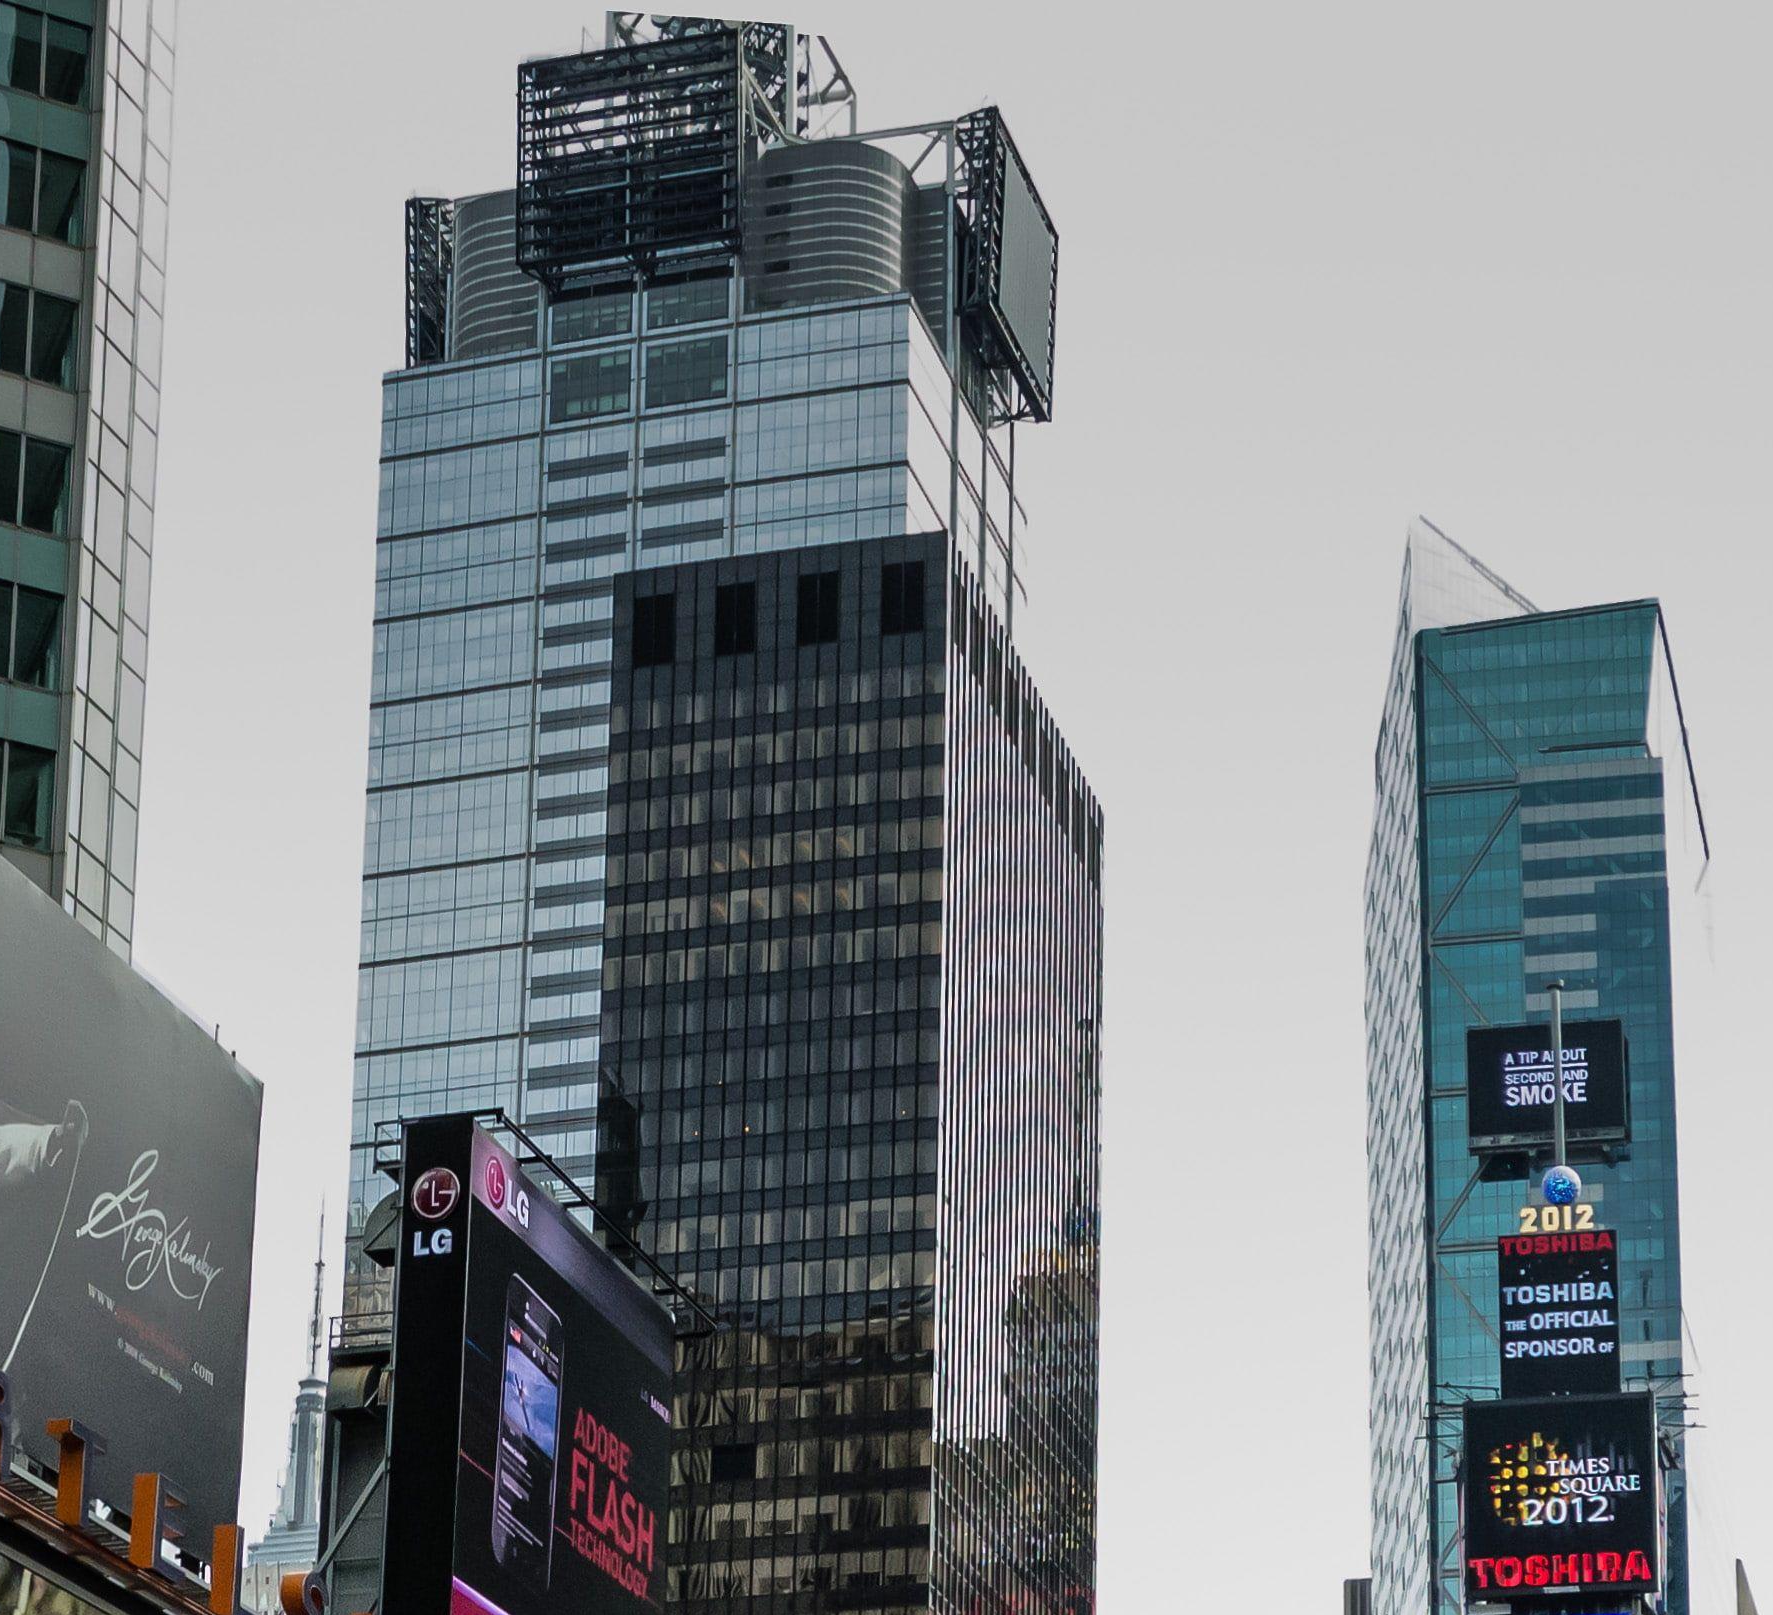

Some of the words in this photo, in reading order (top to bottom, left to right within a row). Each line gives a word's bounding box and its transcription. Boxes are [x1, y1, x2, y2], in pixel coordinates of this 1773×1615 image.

[1520, 1204, 1594, 1232] 2012
[413, 1231, 452, 1256] LG
[1499, 1232, 1613, 1255] TOSHIBA
[1503, 1282, 1614, 1305] TOSHIBA
[1505, 1320, 1527, 1331] THE
[1529, 1310, 1615, 1329] OFFICIAL
[1505, 1337, 1596, 1358] SPONSOR
[1600, 1342, 1614, 1353] OF
[574, 1407, 630, 1482] ADOBE
[1545, 1458, 1610, 1477] TIMES
[1560, 1474, 1641, 1496] SQUARE
[570, 1449, 656, 1572] FLASH
[570, 1518, 648, 1600] TECHNOLOGY
[1469, 1551, 1652, 1588] TOSHIBA
